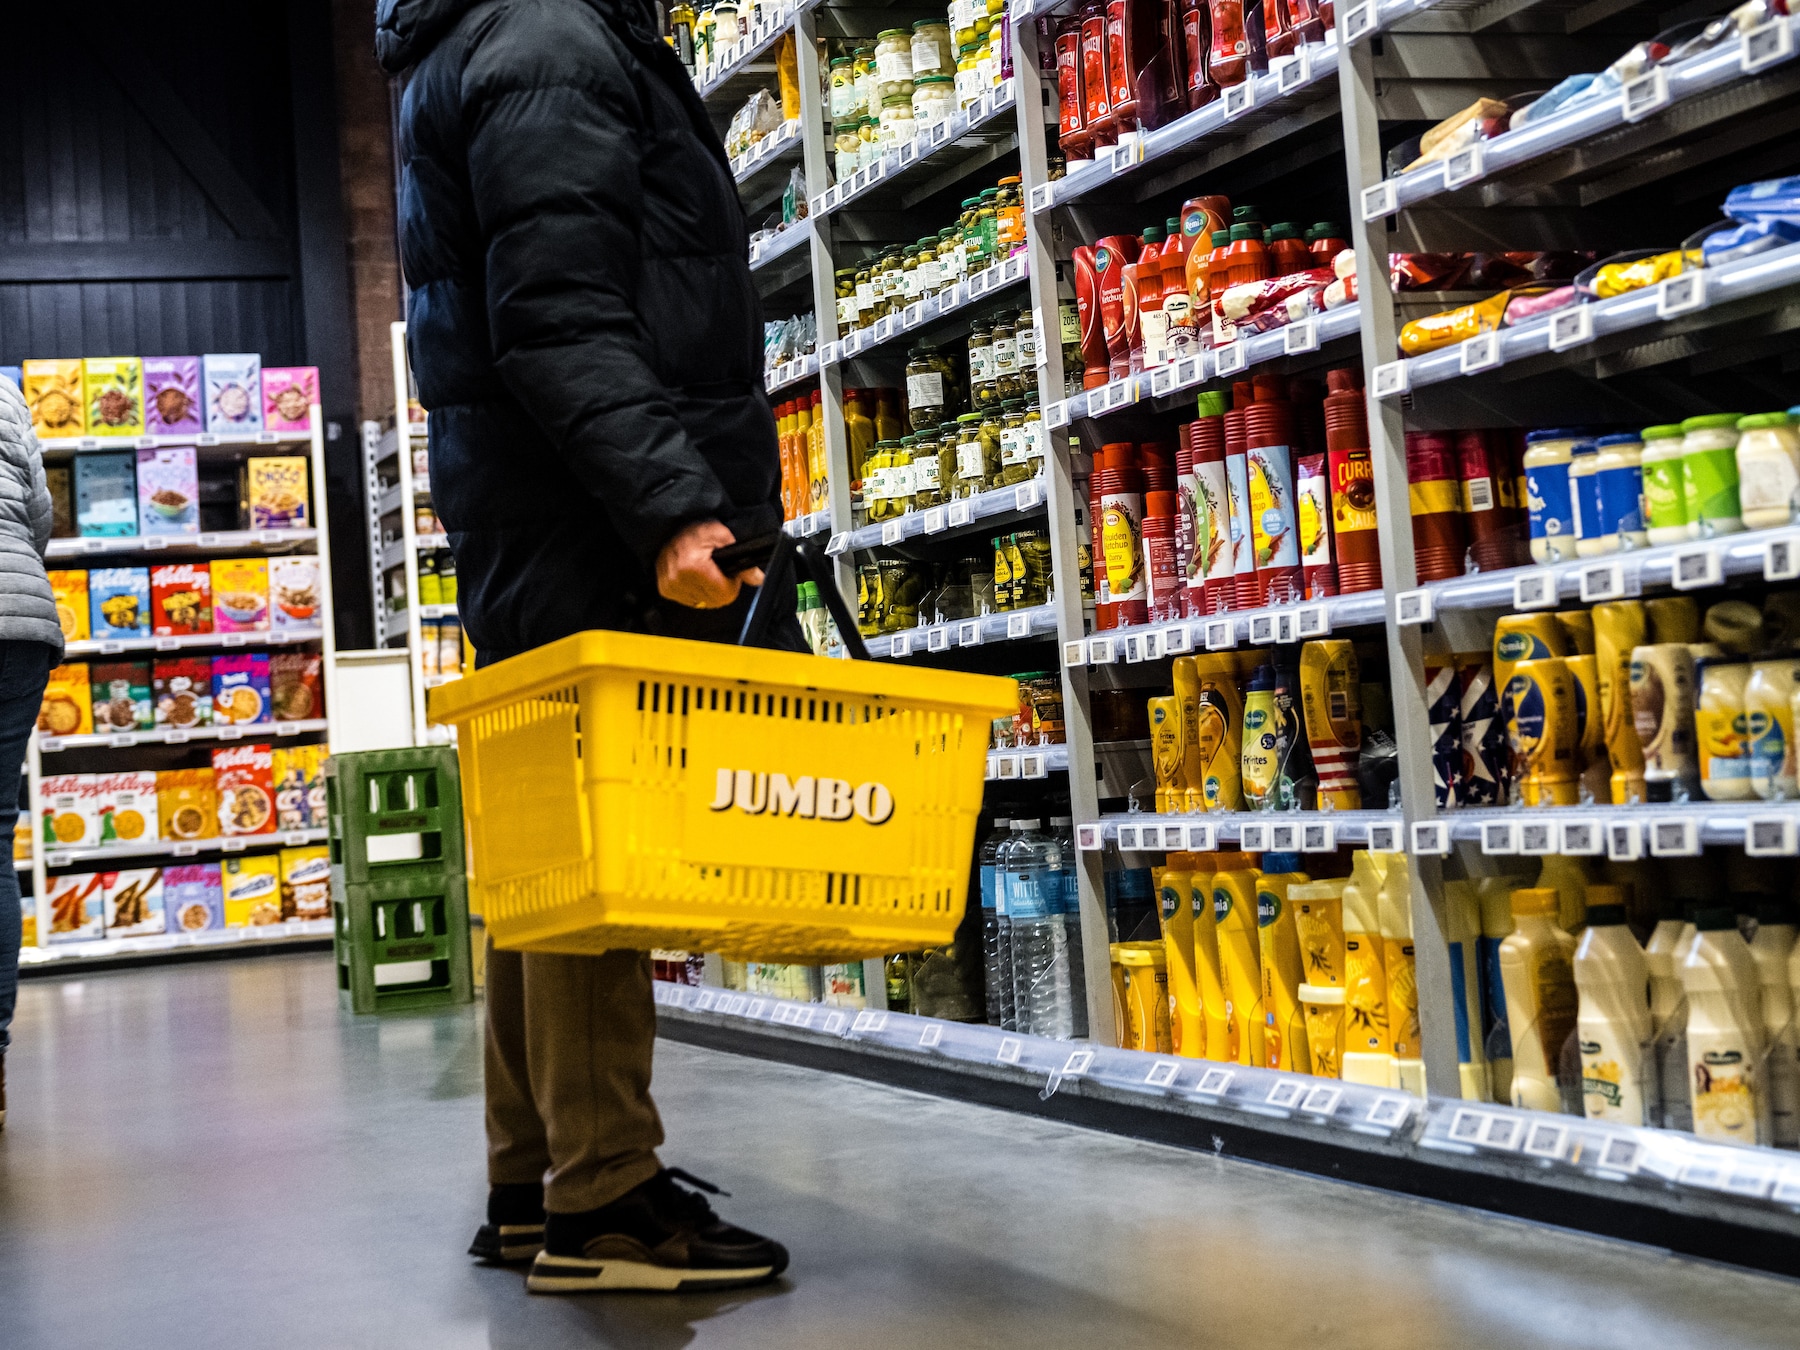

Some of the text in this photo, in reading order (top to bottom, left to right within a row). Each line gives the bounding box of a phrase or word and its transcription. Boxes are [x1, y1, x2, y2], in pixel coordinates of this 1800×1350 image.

[1185, 217, 1204, 231] Remia
[1194, 254, 1212, 263] Curr
[1338, 460, 1373, 486] CURR
[1347, 510, 1377, 528] SAUS
[709, 768, 895, 826] JUMBO
[1012, 880, 1040, 899] WITTE
